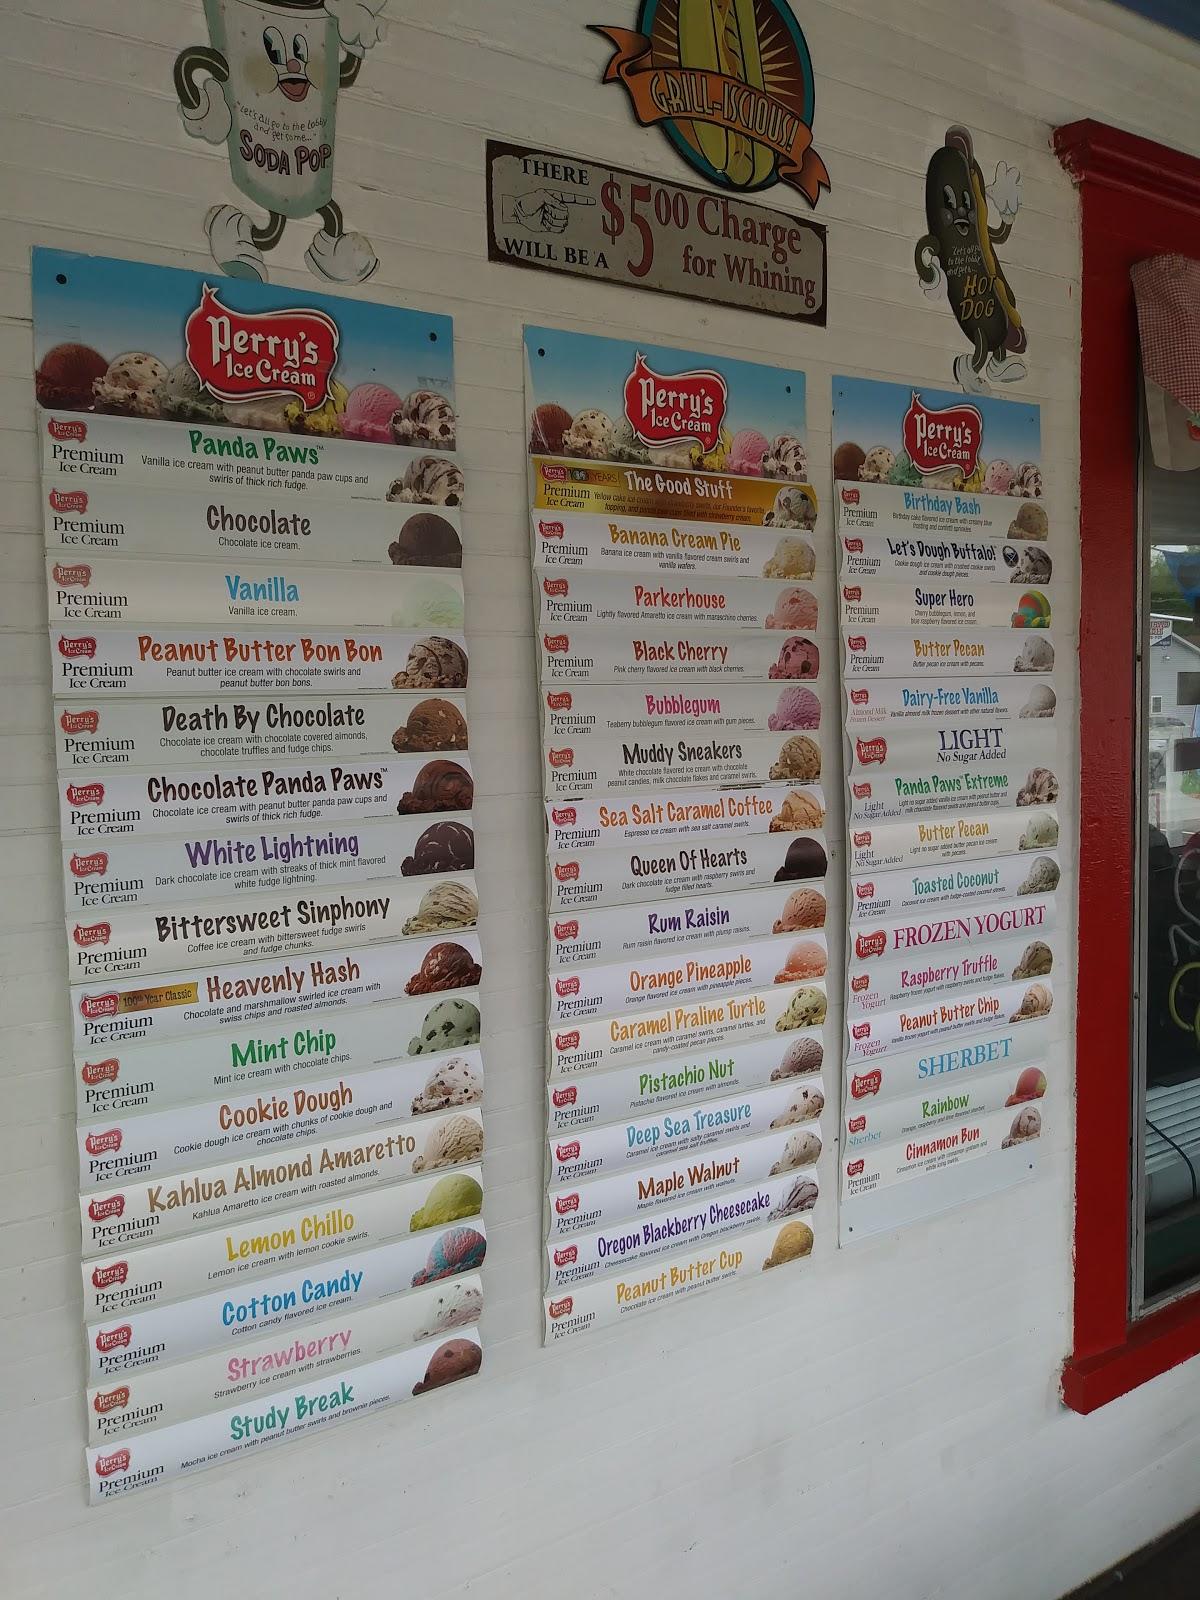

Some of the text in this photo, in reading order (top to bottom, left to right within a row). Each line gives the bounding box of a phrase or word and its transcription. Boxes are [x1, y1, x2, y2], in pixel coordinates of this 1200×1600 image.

[254, 123, 270, 135] and
[272, 131, 283, 141] get
[282, 122, 289, 130] to
[293, 123, 305, 131] the
[240, 129, 331, 175] SODA POP
[519, 159, 590, 186] THERE
[697, 197, 801, 264] Charge
[503, 237, 609, 269] WILL BE A
[683, 245, 816, 309] for Whining
[960, 299, 995, 321] DOG
[206, 314, 319, 369] Perry's
[226, 355, 316, 387] Ice Cream
[639, 377, 713, 418] Perry's
[651, 408, 711, 433] Ice Cream
[914, 413, 972, 448] Perry's
[51, 444, 124, 465] Premium
[189, 430, 258, 459] Panda
[924, 440, 970, 460] Ice Cream
[59, 463, 117, 476] Ice Cream
[141, 456, 369, 485] Vanilla ice cream with peanut butter panda paw cups and
[209, 474, 308, 491] swirls of thick rich fudge.
[624, 470, 733, 500] The Good Stuff
[904, 492, 981, 515] Birthday Bash
[206, 505, 311, 536] Chocolate
[847, 555, 881, 567] Premium
[887, 538, 997, 564] Let's Dough Buffalo!
[225, 576, 299, 602] Vanilla
[635, 585, 725, 608] Parkerhouse
[915, 588, 974, 610] Super Hero
[228, 606, 298, 617] Vanilla ice cream.
[138, 636, 382, 663] Peanut Butter Bon Bon
[633, 641, 728, 663] Black Cherry
[913, 639, 985, 657] Butter Pecan
[646, 694, 721, 717] Bubblegum
[903, 687, 999, 709] Dairy-Free Vanilla
[162, 703, 365, 733] Death By Chocolate
[622, 741, 742, 765] Muddy Sneakers
[938, 728, 1003, 751] LIGHT
[937, 749, 1006, 764] No Sugar Added
[895, 777, 930, 796] Panda
[964, 772, 1008, 790] Extreme
[599, 795, 772, 827] Sea Salt Caramel Coffee
[864, 801, 884, 811] Light
[185, 831, 359, 868] White Lightning
[630, 847, 747, 877] Queen Of Hearts
[912, 869, 999, 896] Toasted Coconut
[155, 895, 390, 942] Bittersweet Sinphony
[648, 908, 730, 933] Rum Raisin
[893, 905, 1046, 949] FROZEN YOGURT
[206, 958, 360, 1002] Heavenly Hash
[901, 955, 998, 988] Raspberry Truffle
[165, 988, 192, 1002] Classic
[610, 996, 765, 1041] Caramel Praline Turtle
[232, 1029, 337, 1067] Mint Chip
[919, 1037, 1013, 1079] SHERBET
[214, 1053, 352, 1085] Mint ice cream with chocolate chips.
[639, 1059, 735, 1095] Pistachio Nut
[922, 1094, 970, 1118] Rainbow
[626, 1103, 752, 1148] Deep Sea Treasure
[906, 1127, 980, 1161] Cinnamon Bun
[147, 1134, 416, 1213] Kahlua Almond Amaretto
[637, 1157, 740, 1201] Maple Walnut
[226, 1209, 354, 1260] Lemon Chillo
[598, 1191, 770, 1257] Oregon Blackberry Cheesecake
[227, 1329, 353, 1382] Strawberry
[230, 1382, 355, 1440] Study Break
